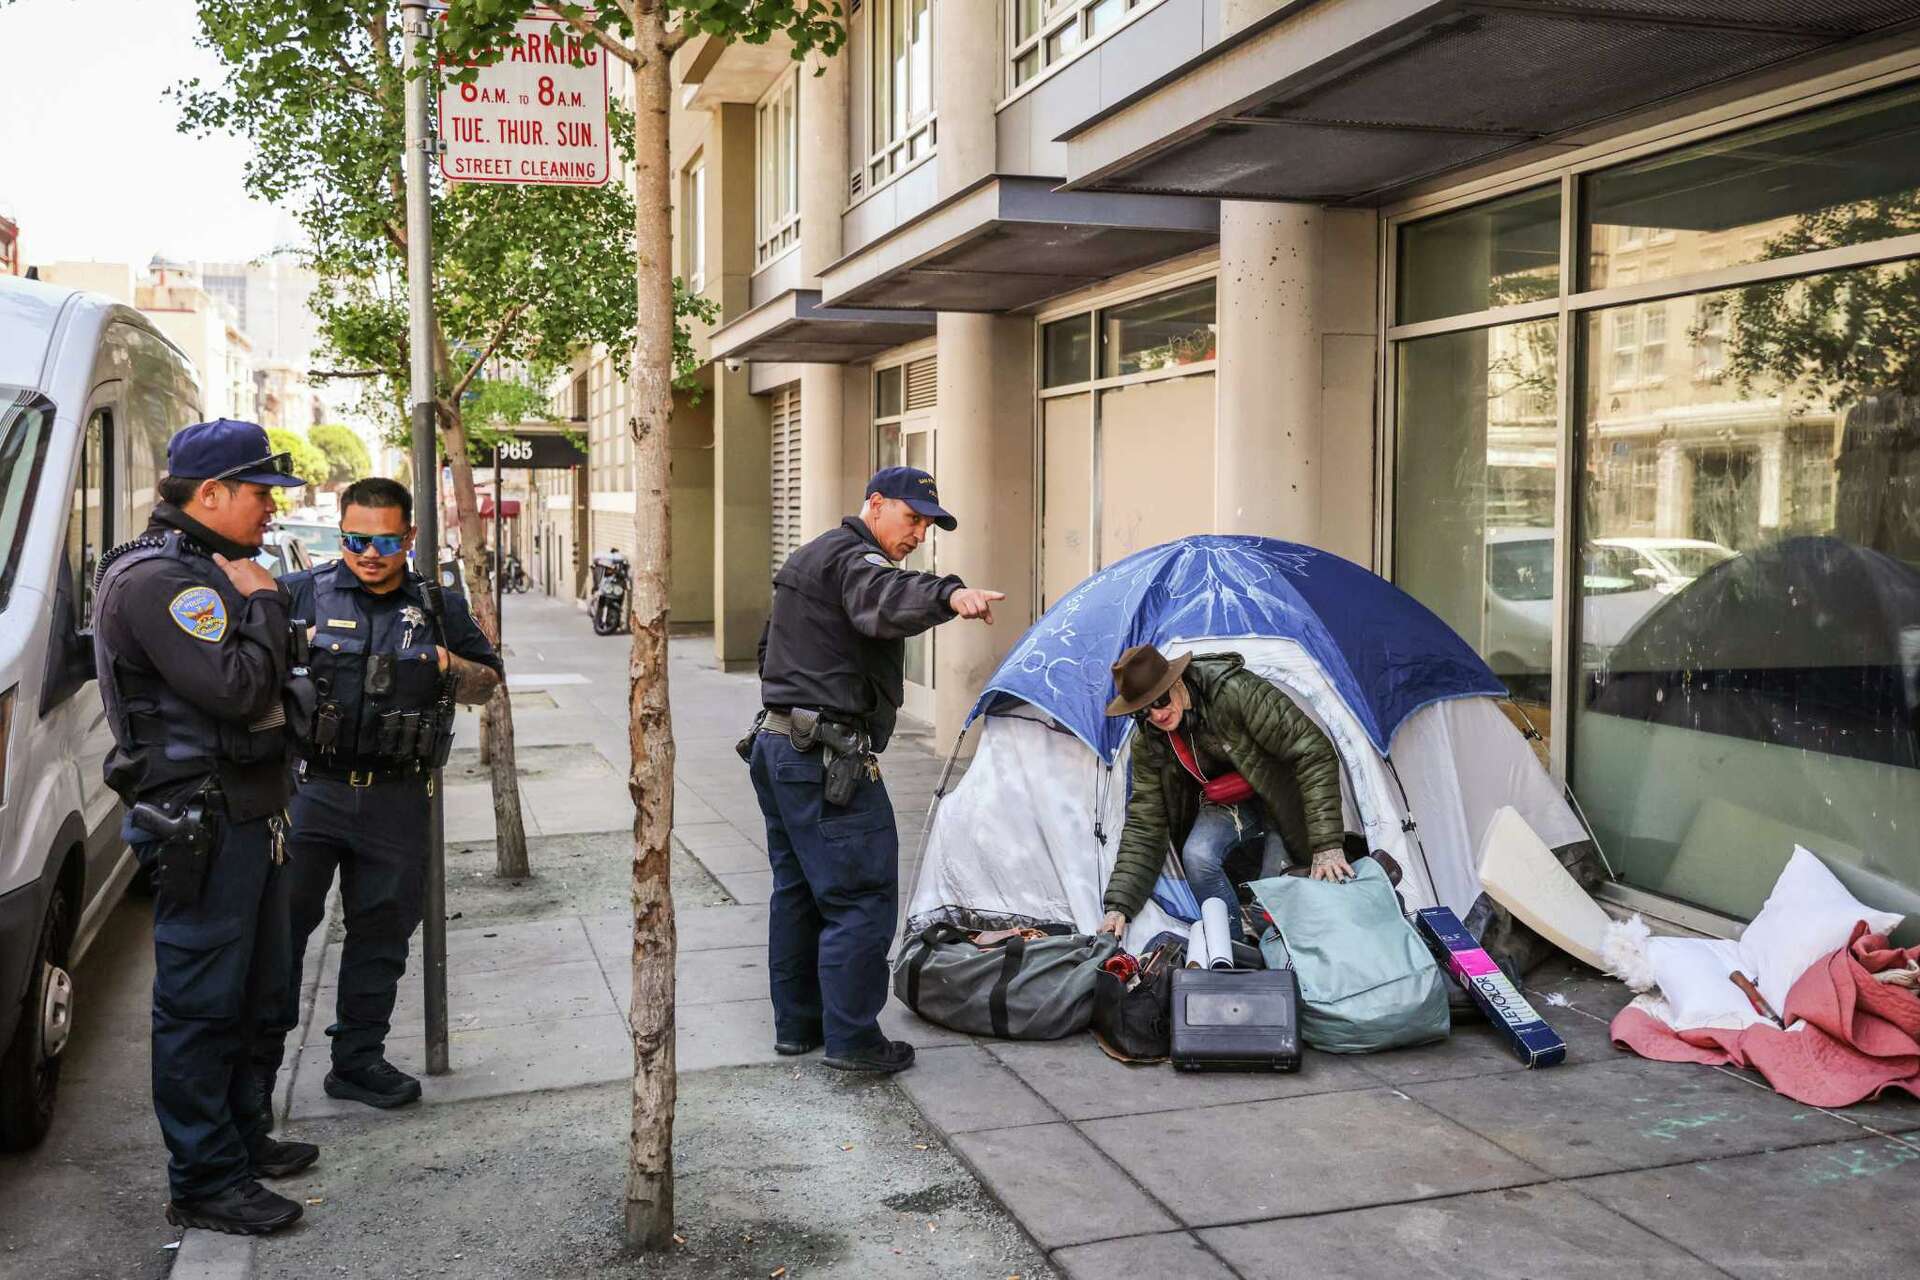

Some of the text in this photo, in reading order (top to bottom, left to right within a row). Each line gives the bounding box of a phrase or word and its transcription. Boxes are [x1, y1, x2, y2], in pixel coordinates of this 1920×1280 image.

[519, 95, 529, 105] TO
[452, 117, 598, 148] TUE. THUR. SUN.
[455, 158, 596, 178] STREET CLEANING
[498, 441, 533, 460] 965
[1476, 976, 1522, 1023] LEVOLOR
